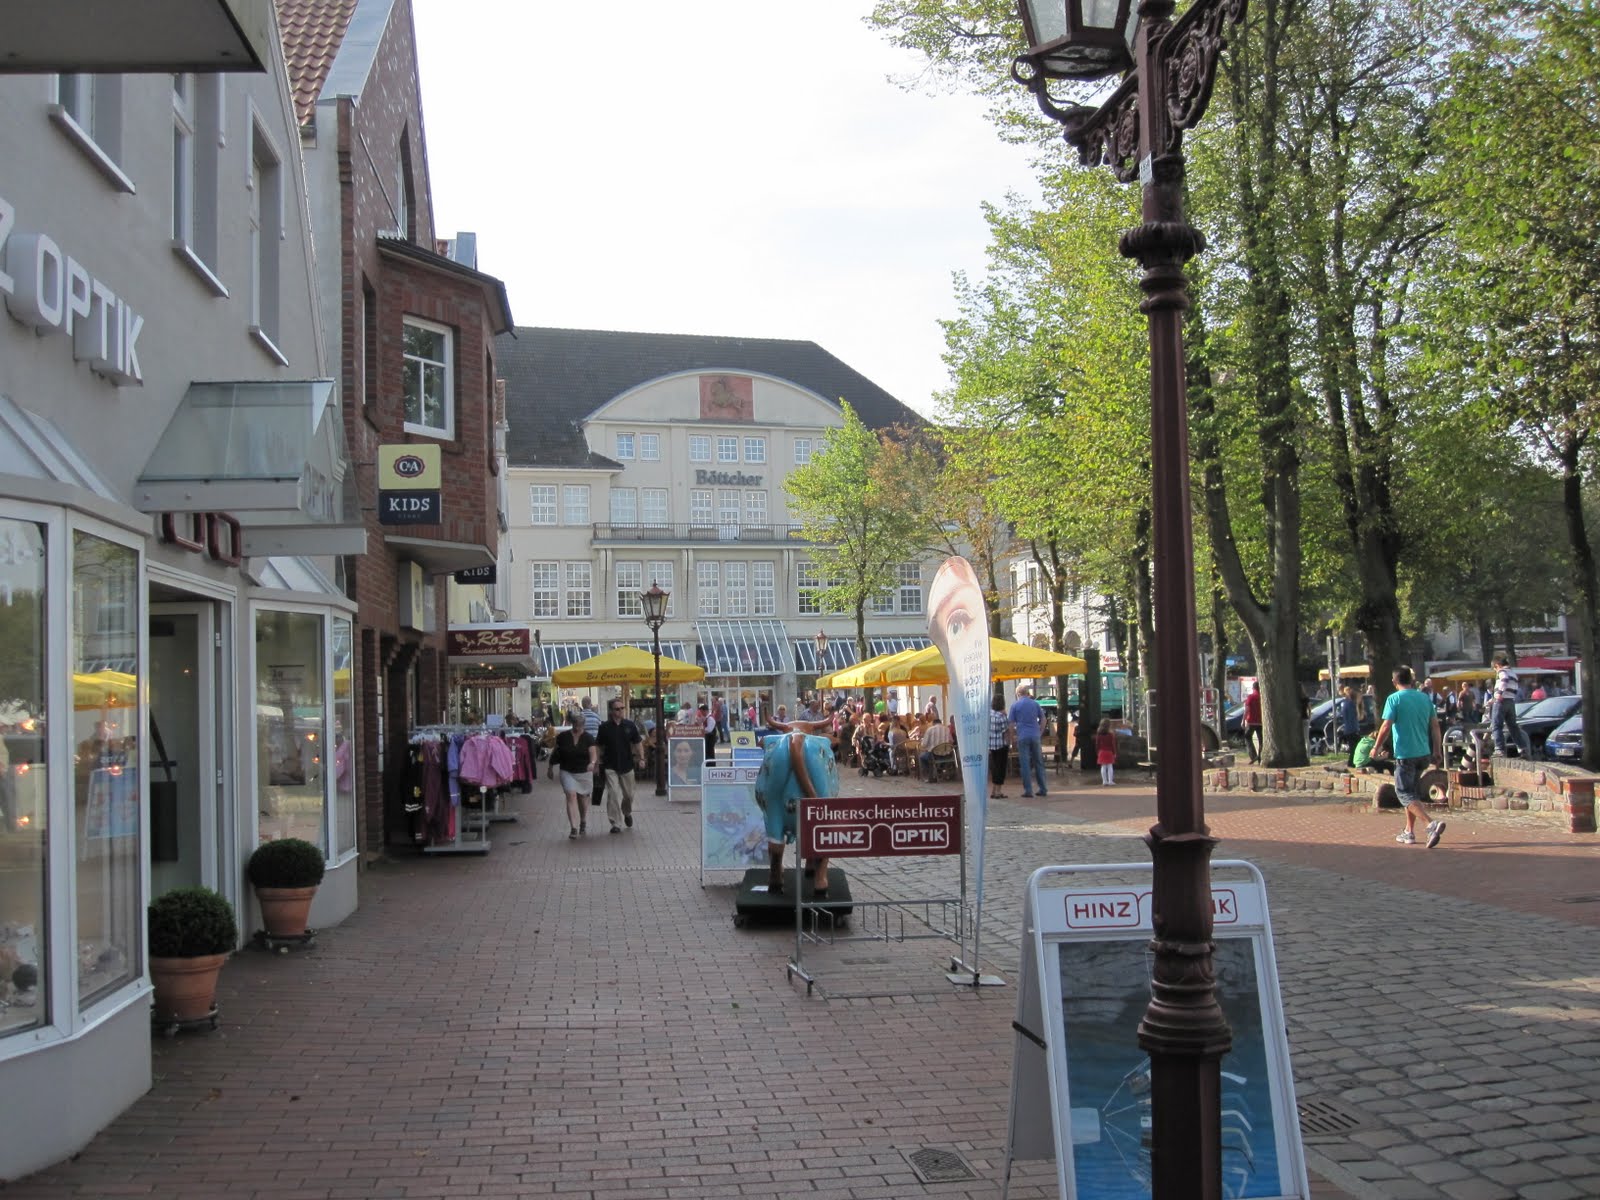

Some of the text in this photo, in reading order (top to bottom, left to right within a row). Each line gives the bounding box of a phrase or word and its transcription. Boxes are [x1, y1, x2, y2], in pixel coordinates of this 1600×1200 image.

[37, 233, 144, 380] OPTIK
[399, 461, 419, 472] C&A
[695, 469, 763, 486] Böttcher
[389, 497, 430, 511] KIDS
[463, 567, 490, 576] KIDS
[477, 630, 522, 646] RoSa
[711, 771, 733, 779] HINZ
[820, 829, 945, 845] HINZ OPTIK
[1074, 901, 1131, 919] HINZ
